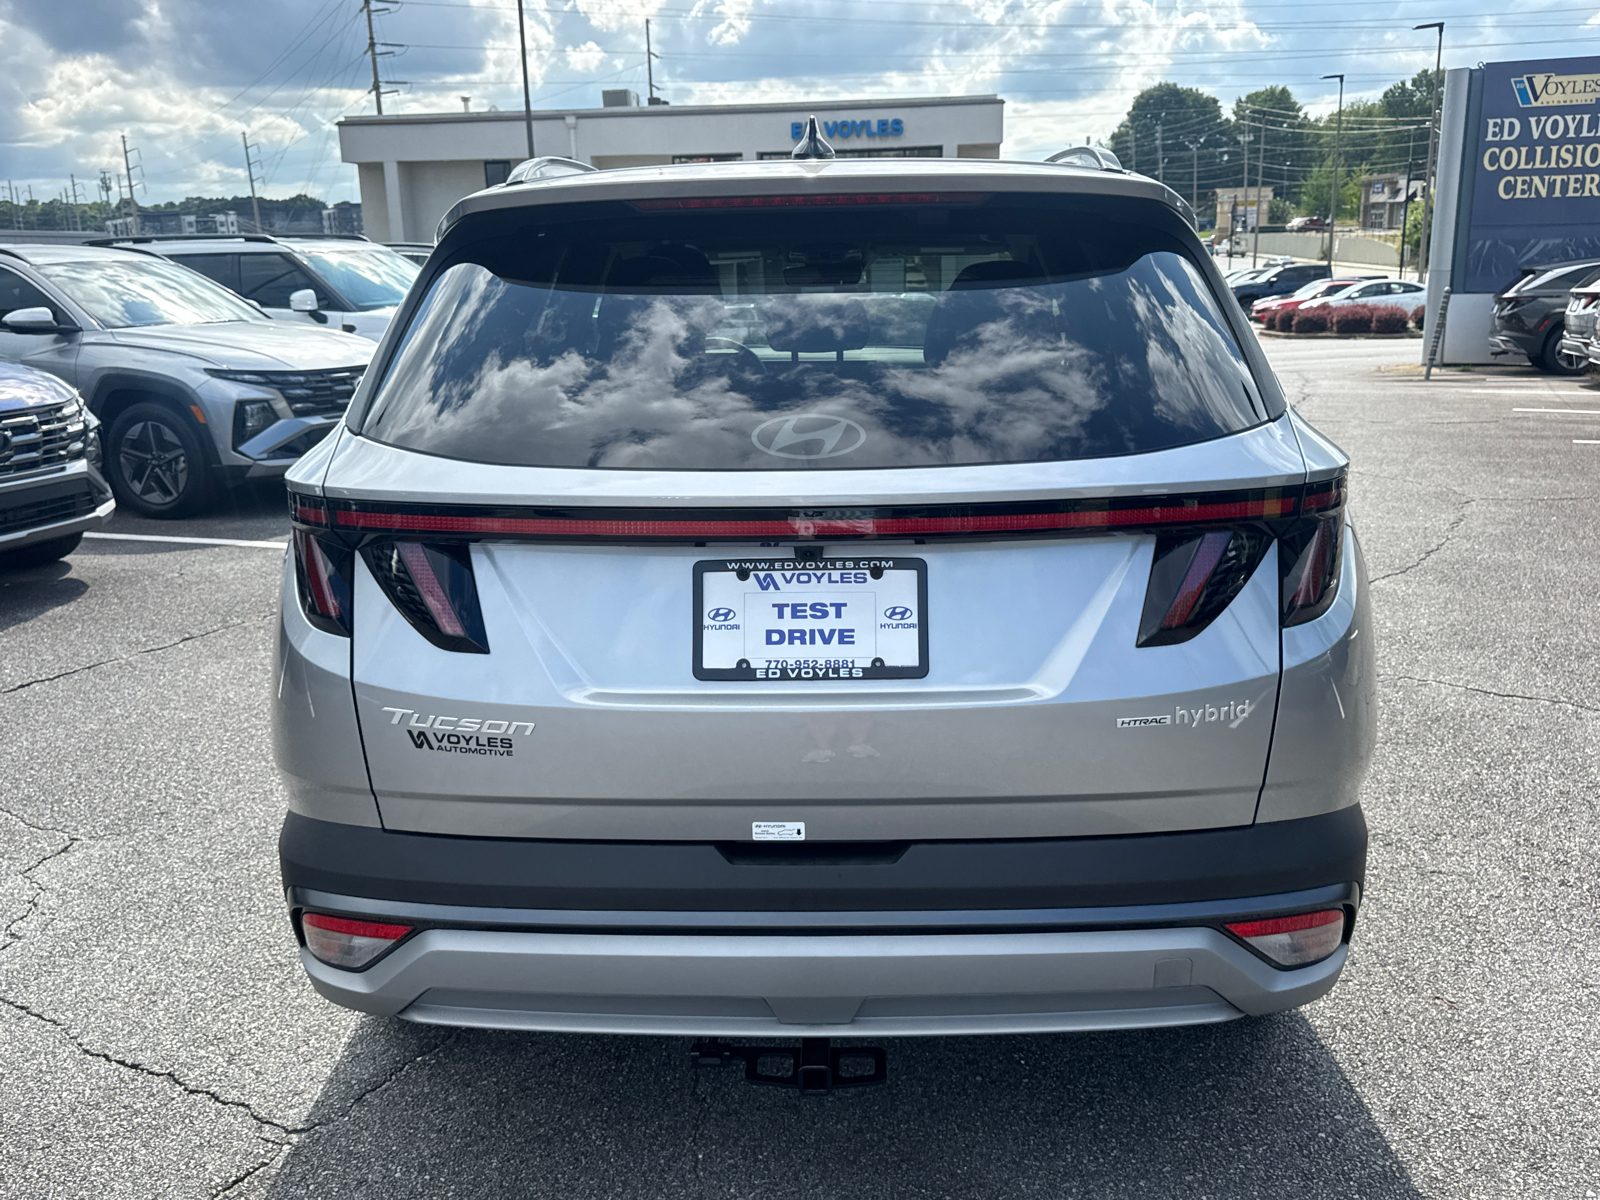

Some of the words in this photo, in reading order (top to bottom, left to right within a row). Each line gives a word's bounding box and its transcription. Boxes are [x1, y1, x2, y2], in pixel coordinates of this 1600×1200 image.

[824, 118, 904, 138] VOYLES
[1485, 118, 1521, 141] ED
[1528, 113, 1600, 140] VOYL
[1498, 174, 1600, 200] CENTER
[727, 560, 893, 570] WWW.EDVOYLES.COM
[781, 571, 868, 585] VOYLES
[772, 602, 847, 619] TEST
[765, 628, 856, 646] DRIVE
[765, 659, 856, 669] 770-952-8881
[756, 669, 781, 678] ED
[788, 668, 864, 678] VOYLES
[1121, 716, 1168, 727] HTRAC
[1175, 699, 1250, 728] hybrid
[433, 732, 514, 749] VOYLES
[436, 745, 514, 757] AUTOMOTIVE
